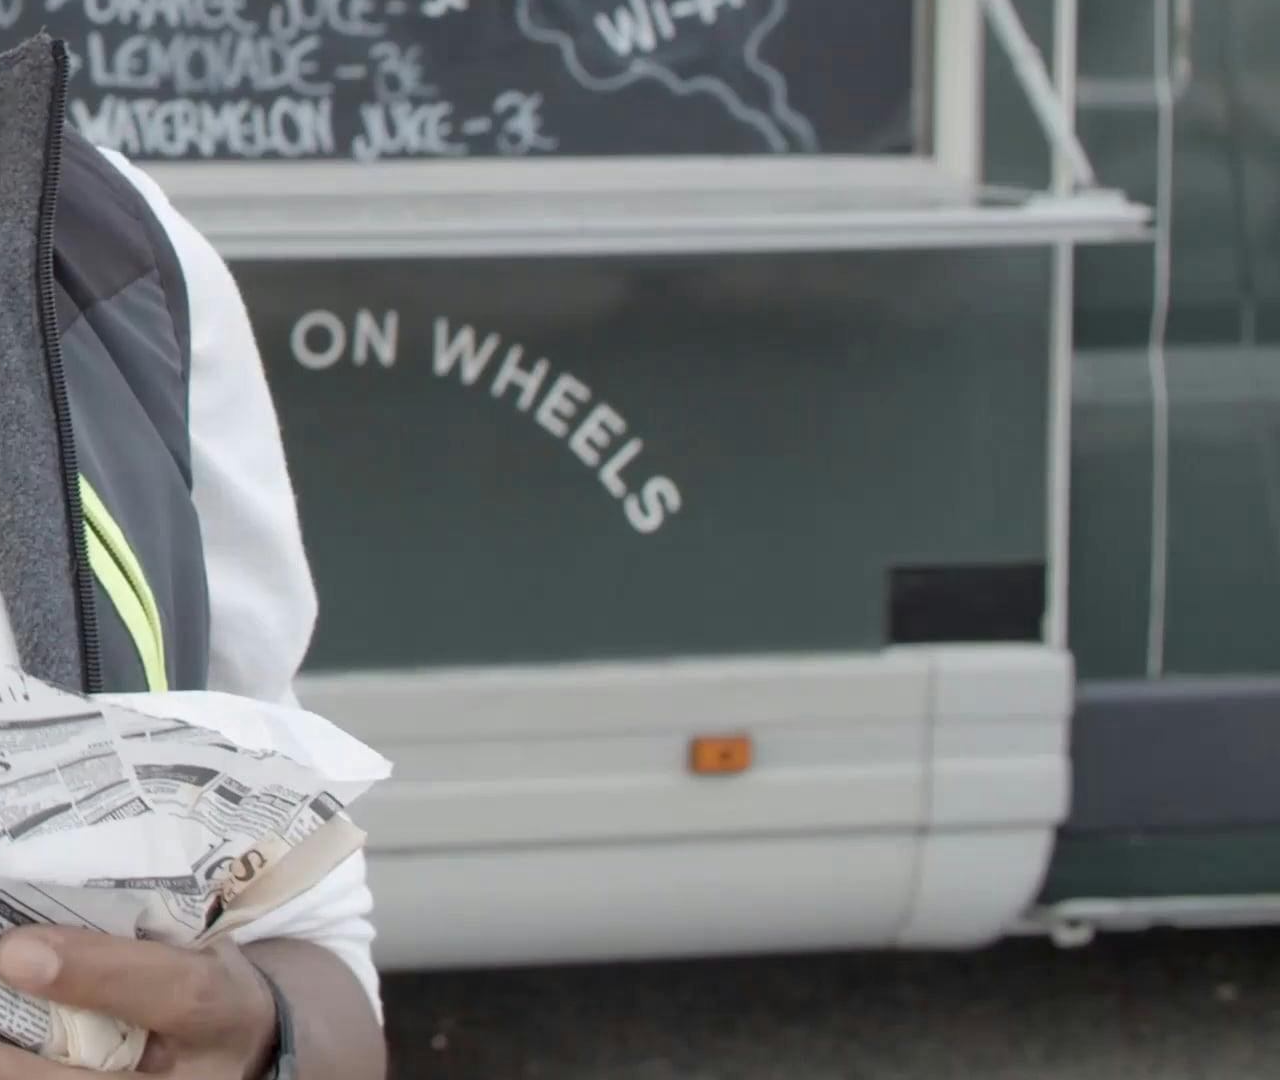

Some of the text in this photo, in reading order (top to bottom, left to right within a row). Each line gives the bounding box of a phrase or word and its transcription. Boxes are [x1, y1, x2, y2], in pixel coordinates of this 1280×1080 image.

[87, 28, 334, 97] LEMONADE
[69, 92, 337, 158] WATERMELON
[290, 307, 684, 535] ON WHEELS
